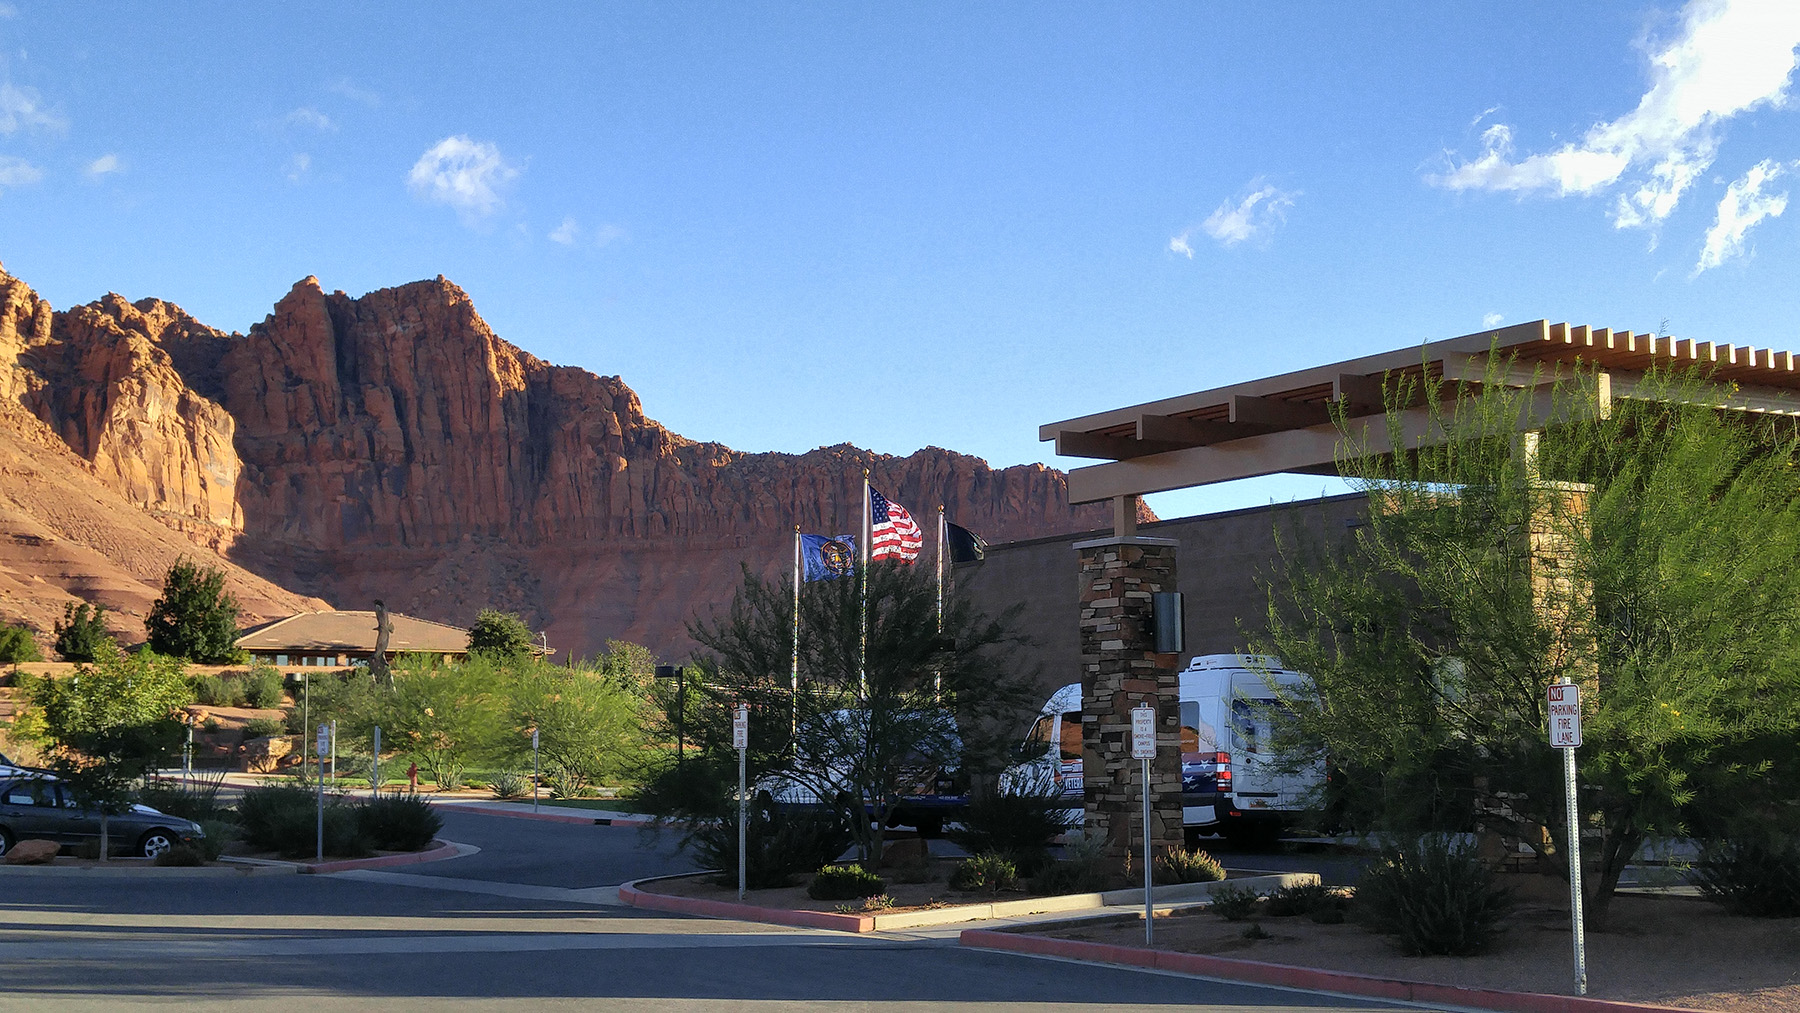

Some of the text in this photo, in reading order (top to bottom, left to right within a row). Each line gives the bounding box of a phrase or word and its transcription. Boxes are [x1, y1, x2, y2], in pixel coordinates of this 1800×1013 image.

[1550, 687, 1562, 700] NO
[1551, 704, 1577, 715] PARKING
[1558, 718, 1571, 729] FIRE
[1557, 732, 1573, 743] LANE
